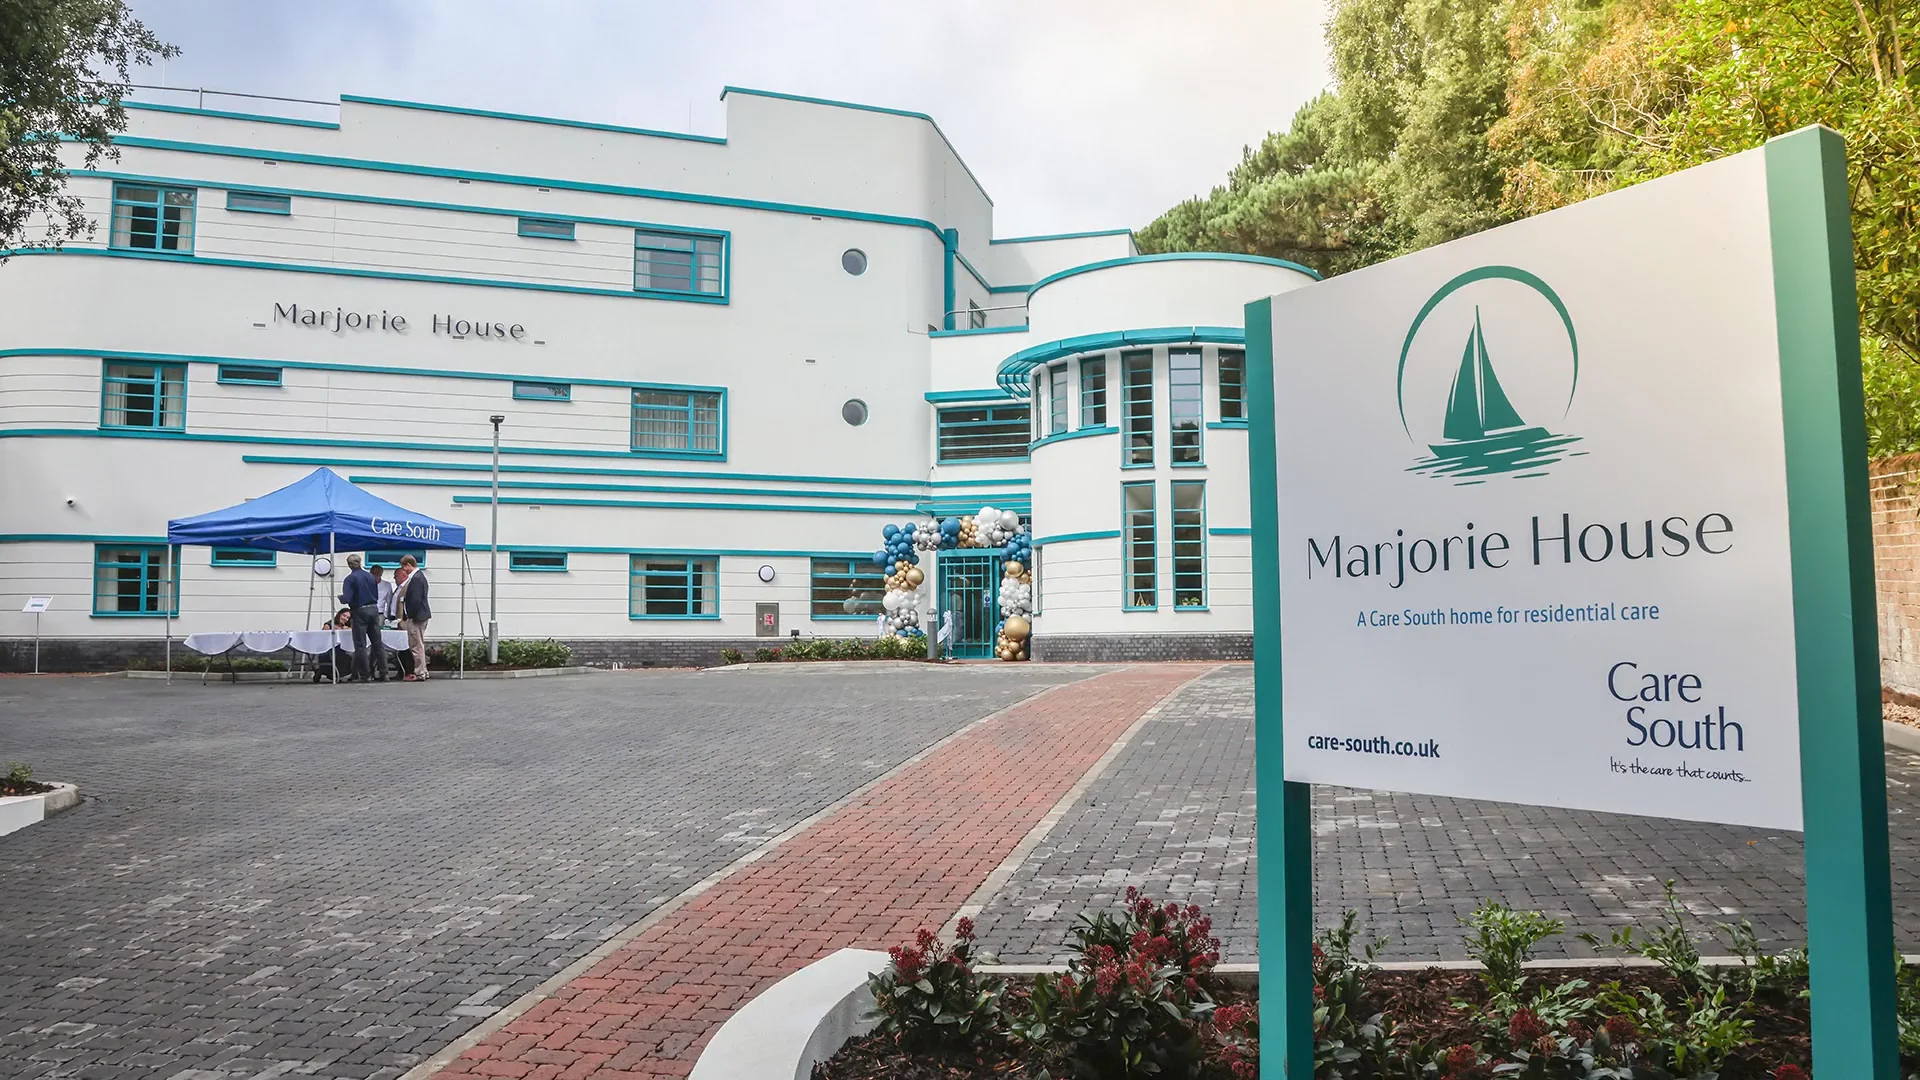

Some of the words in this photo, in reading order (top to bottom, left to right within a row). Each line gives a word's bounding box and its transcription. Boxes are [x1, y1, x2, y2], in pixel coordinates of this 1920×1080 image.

[273, 302, 406, 333] Marjorie
[432, 313, 525, 339] House
[371, 516, 402, 536] Care
[405, 520, 441, 541] South
[1307, 522, 1510, 589] Marjorie
[1531, 512, 1734, 566] House
[1357, 611, 1367, 627] A
[1369, 610, 1400, 627] Care
[1403, 608, 1446, 626] South
[1450, 607, 1493, 625] home
[1497, 606, 1519, 624] for
[1524, 602, 1616, 623] residential
[1621, 604, 1660, 621] care
[1607, 661, 1703, 703] Care
[1626, 705, 1744, 752] South
[1307, 735, 1441, 759] care-south.co.uk
[1610, 756, 1627, 774] It's
[1629, 757, 1650, 775] the
[1650, 765, 1673, 777] care
[1676, 760, 1704, 779] that
